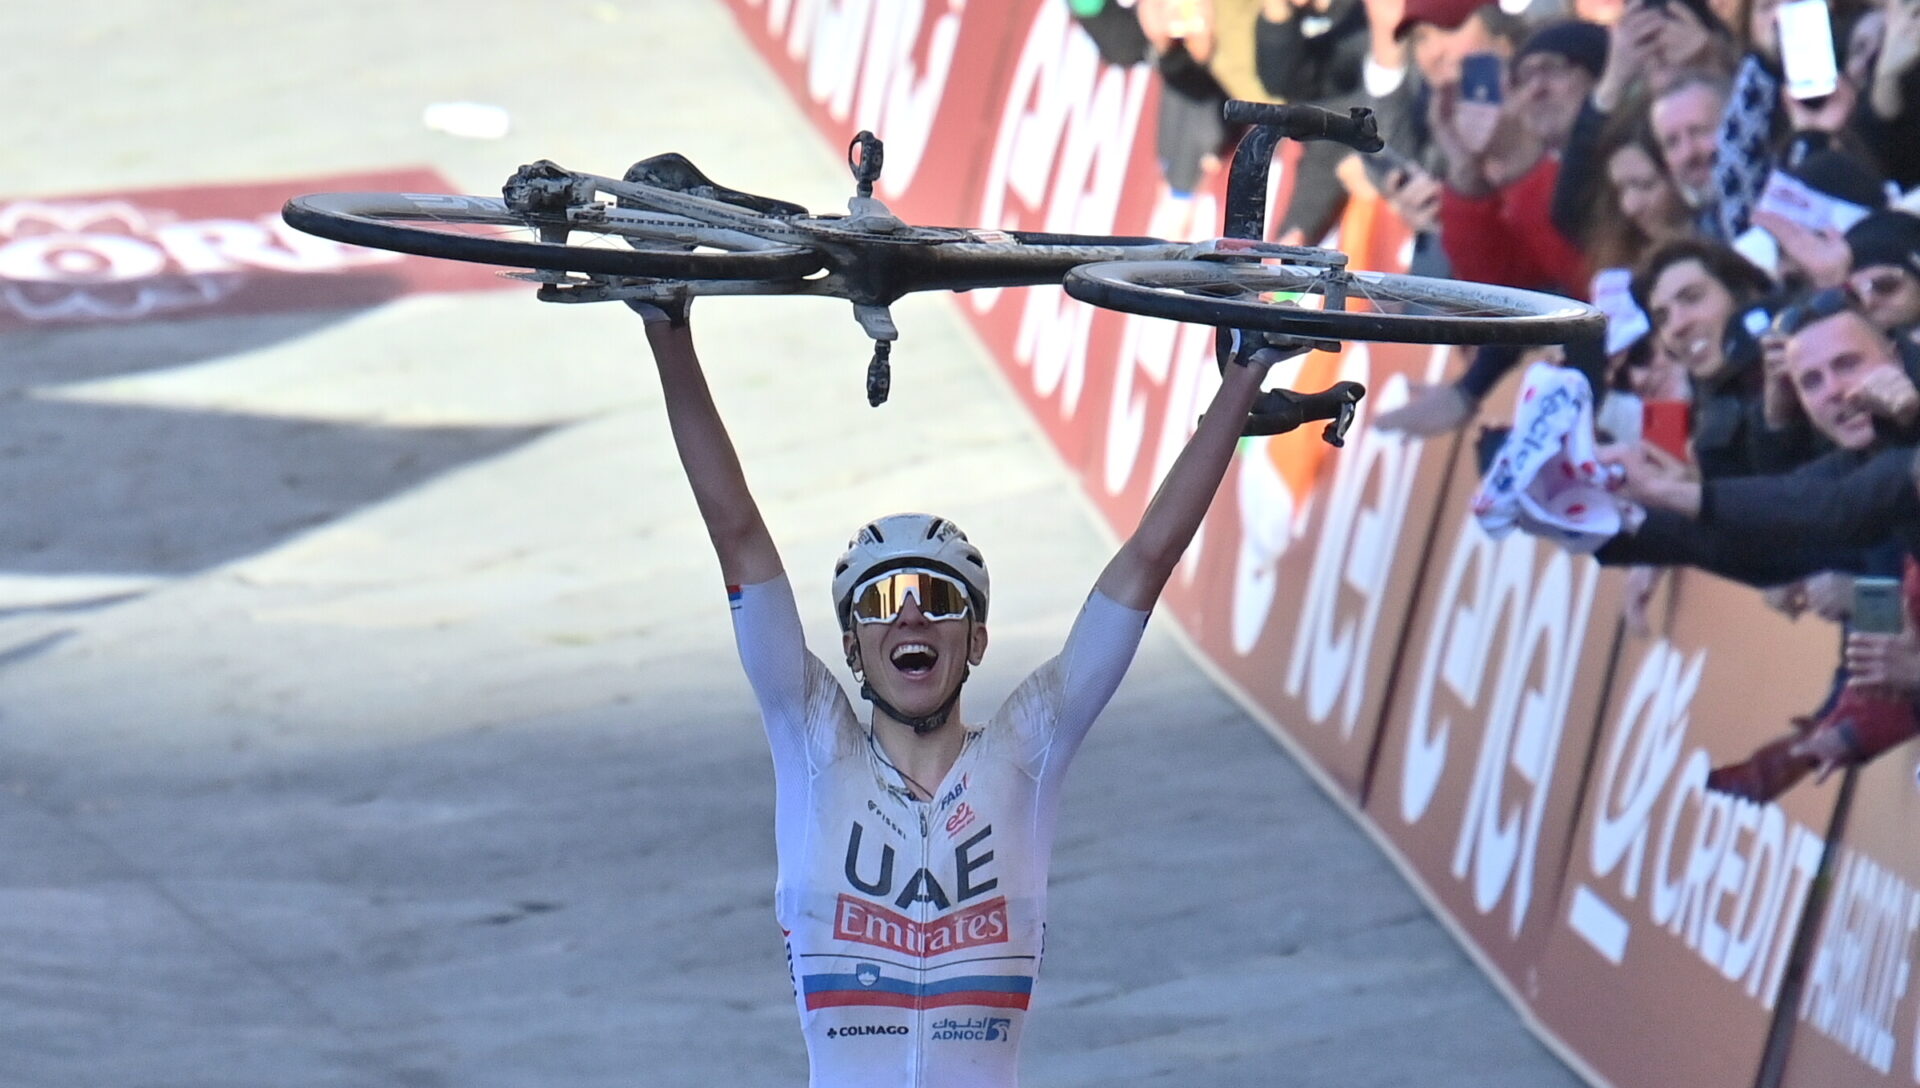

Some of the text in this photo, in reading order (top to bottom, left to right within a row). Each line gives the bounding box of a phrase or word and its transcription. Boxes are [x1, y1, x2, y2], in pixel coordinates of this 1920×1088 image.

[1402, 510, 1602, 939] enel
[845, 820, 999, 910] UAE
[840, 900, 1005, 954] Emirates
[839, 1025, 909, 1037] COLNAGO
[931, 1030, 985, 1041] ADNOC
